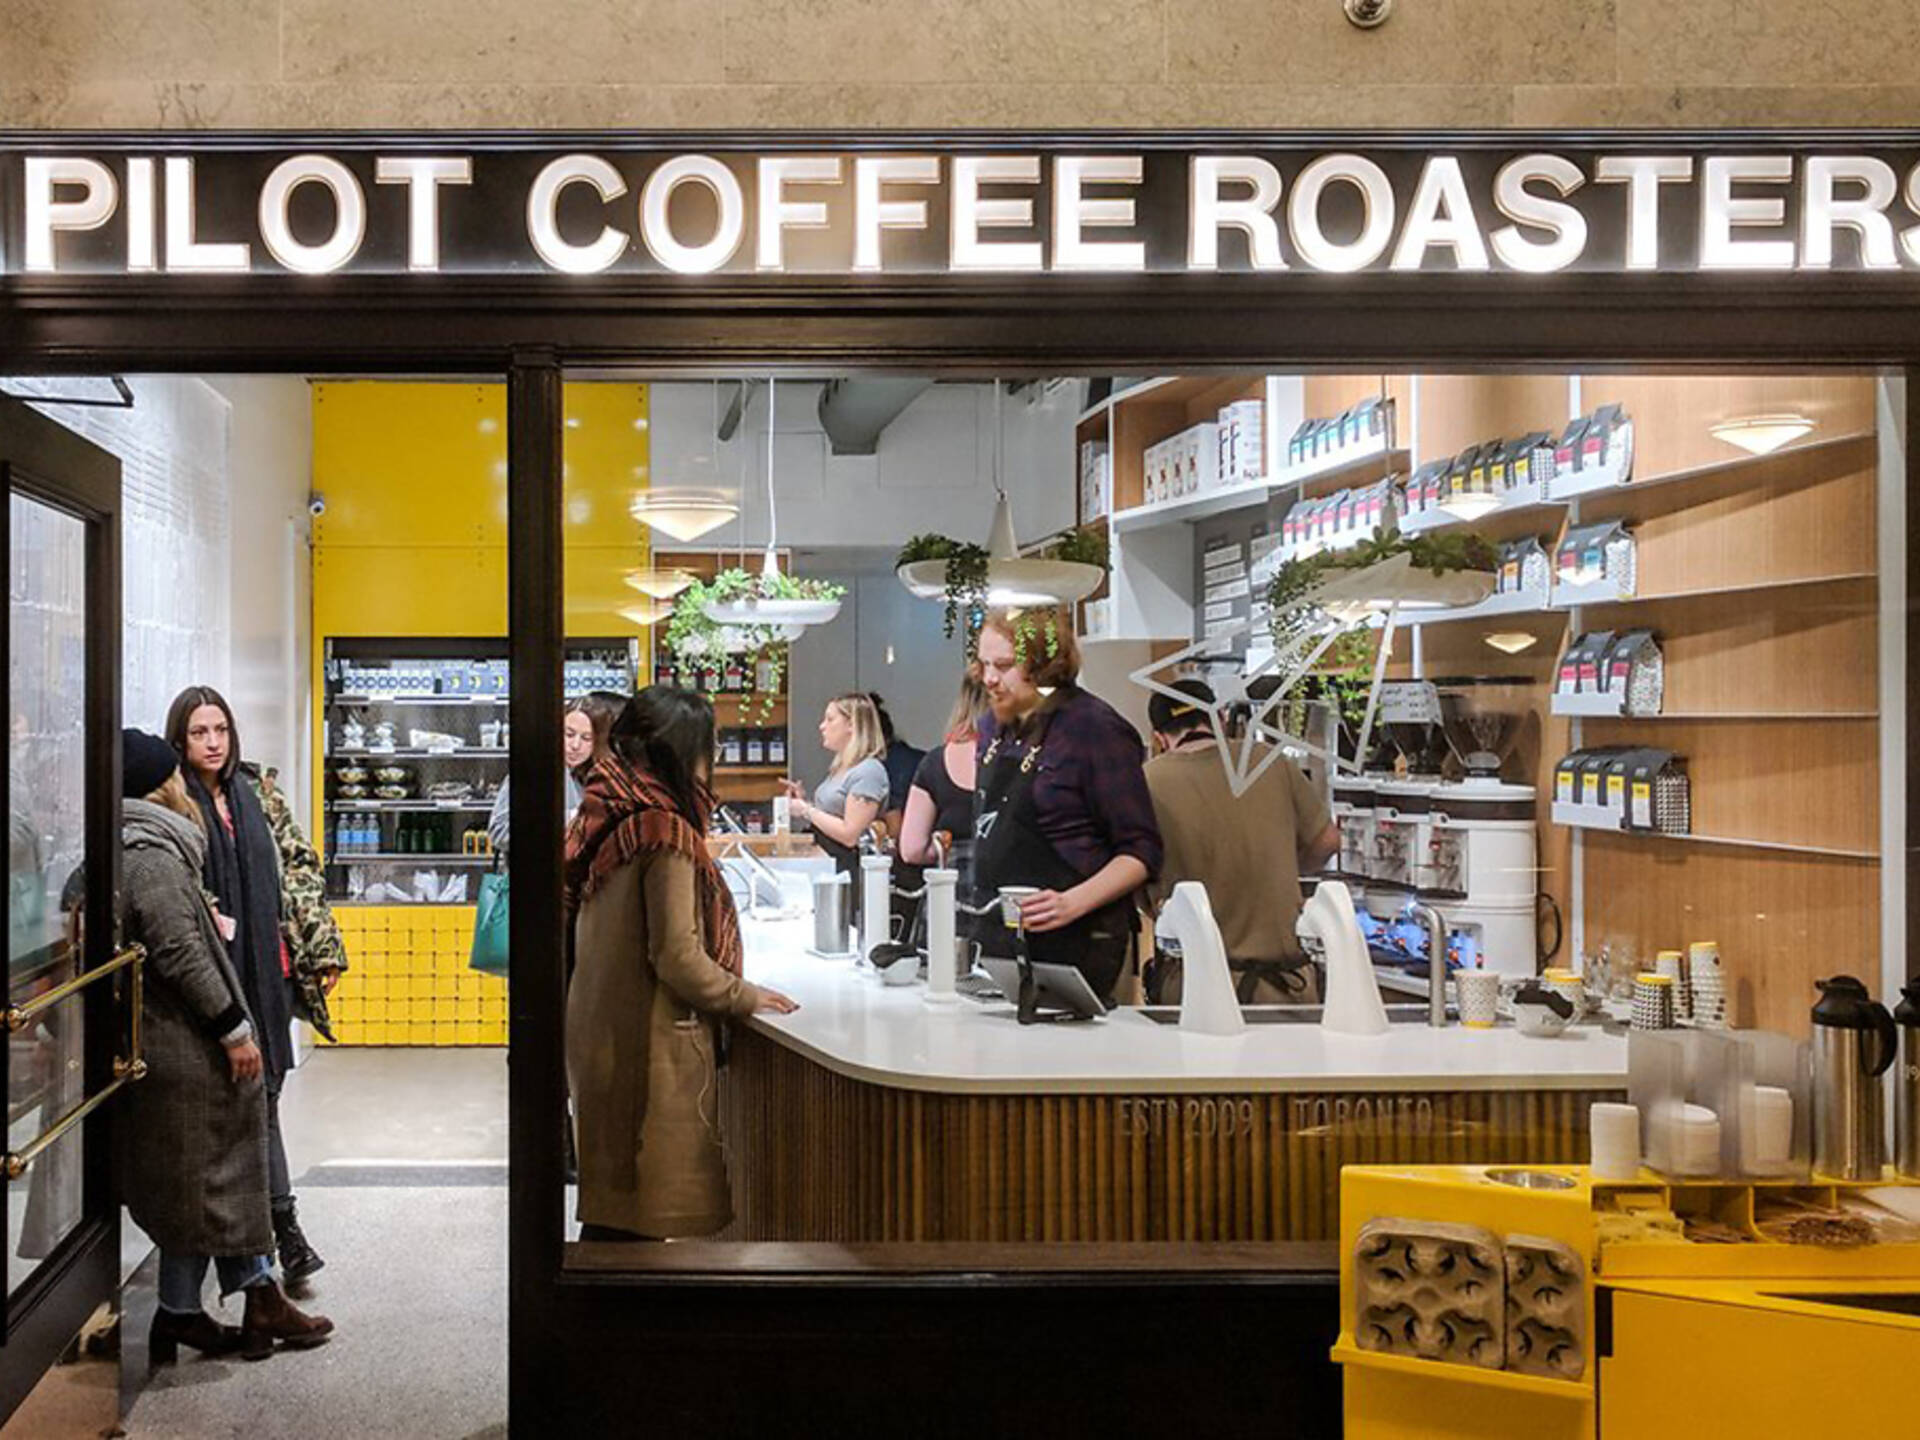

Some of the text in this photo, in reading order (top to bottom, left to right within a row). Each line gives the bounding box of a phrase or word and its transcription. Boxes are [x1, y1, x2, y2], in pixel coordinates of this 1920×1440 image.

[24, 153, 1920, 275] PILOT COFFEE ROASTER
[1187, 1098, 1253, 1137] 2009
[1296, 1097, 1433, 1137] TORONTO
